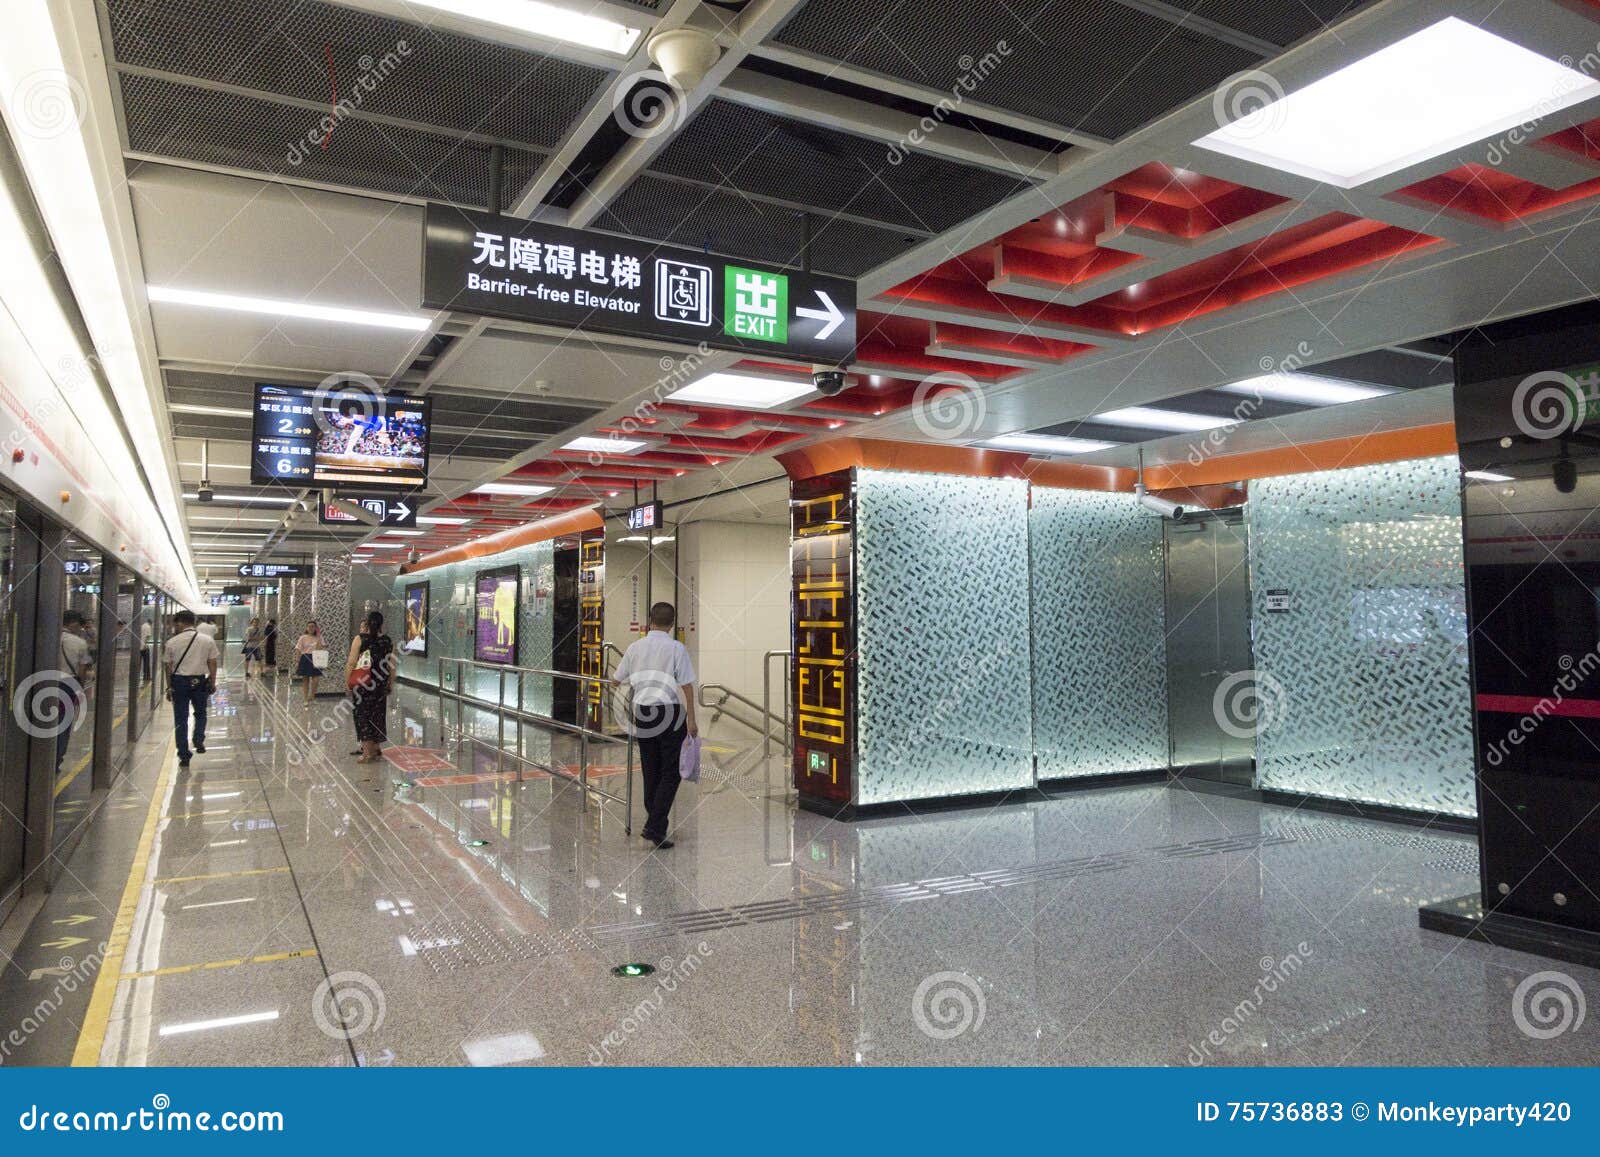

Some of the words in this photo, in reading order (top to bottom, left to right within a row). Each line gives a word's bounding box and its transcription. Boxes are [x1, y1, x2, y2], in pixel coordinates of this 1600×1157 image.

[471, 231, 642, 291] 无障碍电梯
[467, 273, 570, 304] Barrier-free
[574, 288, 641, 315] Elevator
[735, 272, 777, 317] 出
[734, 314, 777, 338] EXIT
[278, 418, 293, 433] 2
[277, 458, 292, 473] 6
